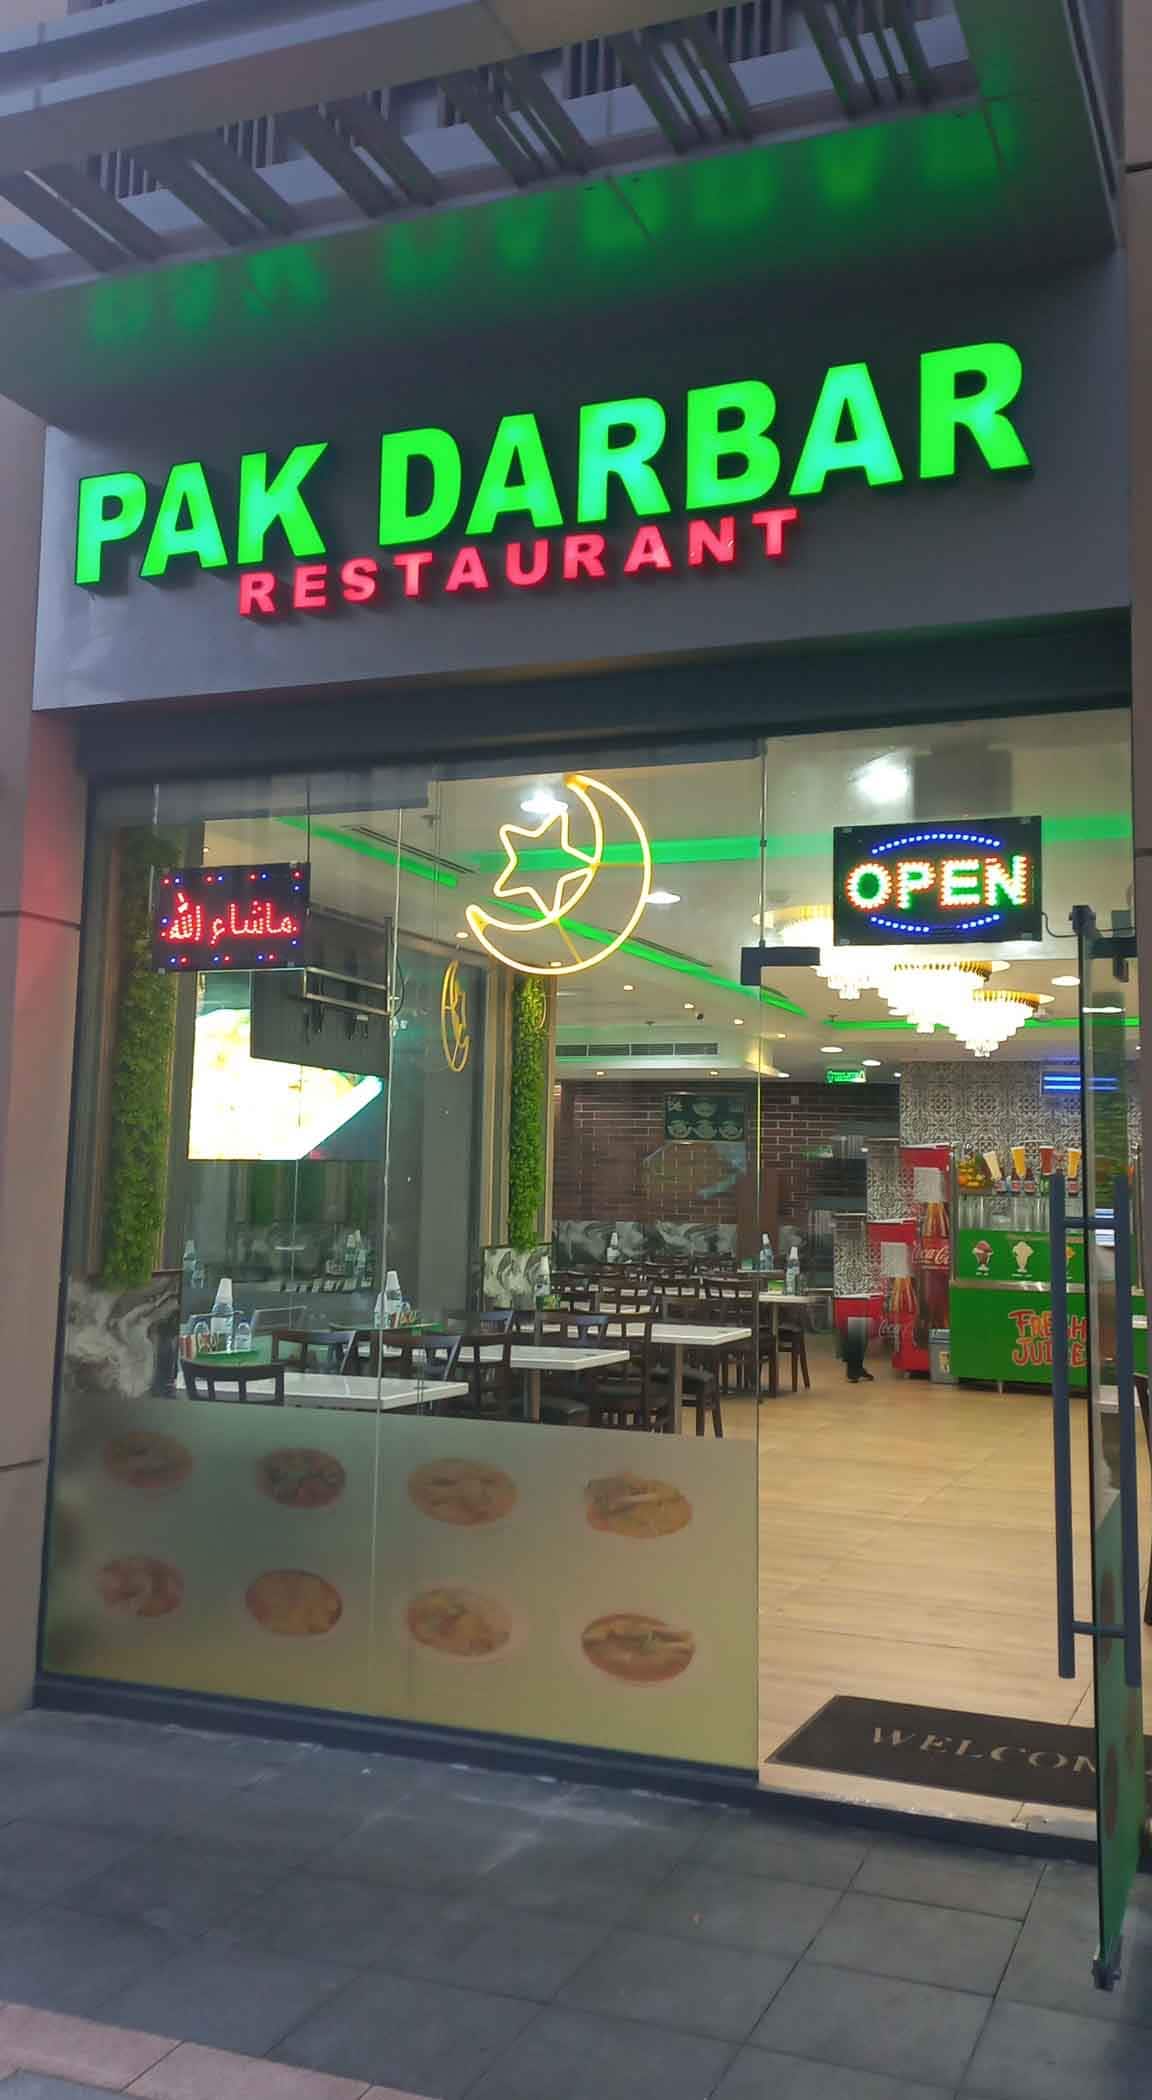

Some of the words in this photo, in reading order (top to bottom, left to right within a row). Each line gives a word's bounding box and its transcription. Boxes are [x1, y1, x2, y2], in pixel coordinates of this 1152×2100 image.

[75, 442, 328, 585] PAK
[378, 342, 1031, 546] DARBAR
[239, 508, 798, 616] RESTAURANT
[846, 855, 1029, 912] OPEN
[1008, 1308, 1088, 1343] FREH
[1012, 1337, 1088, 1367] JUIE
